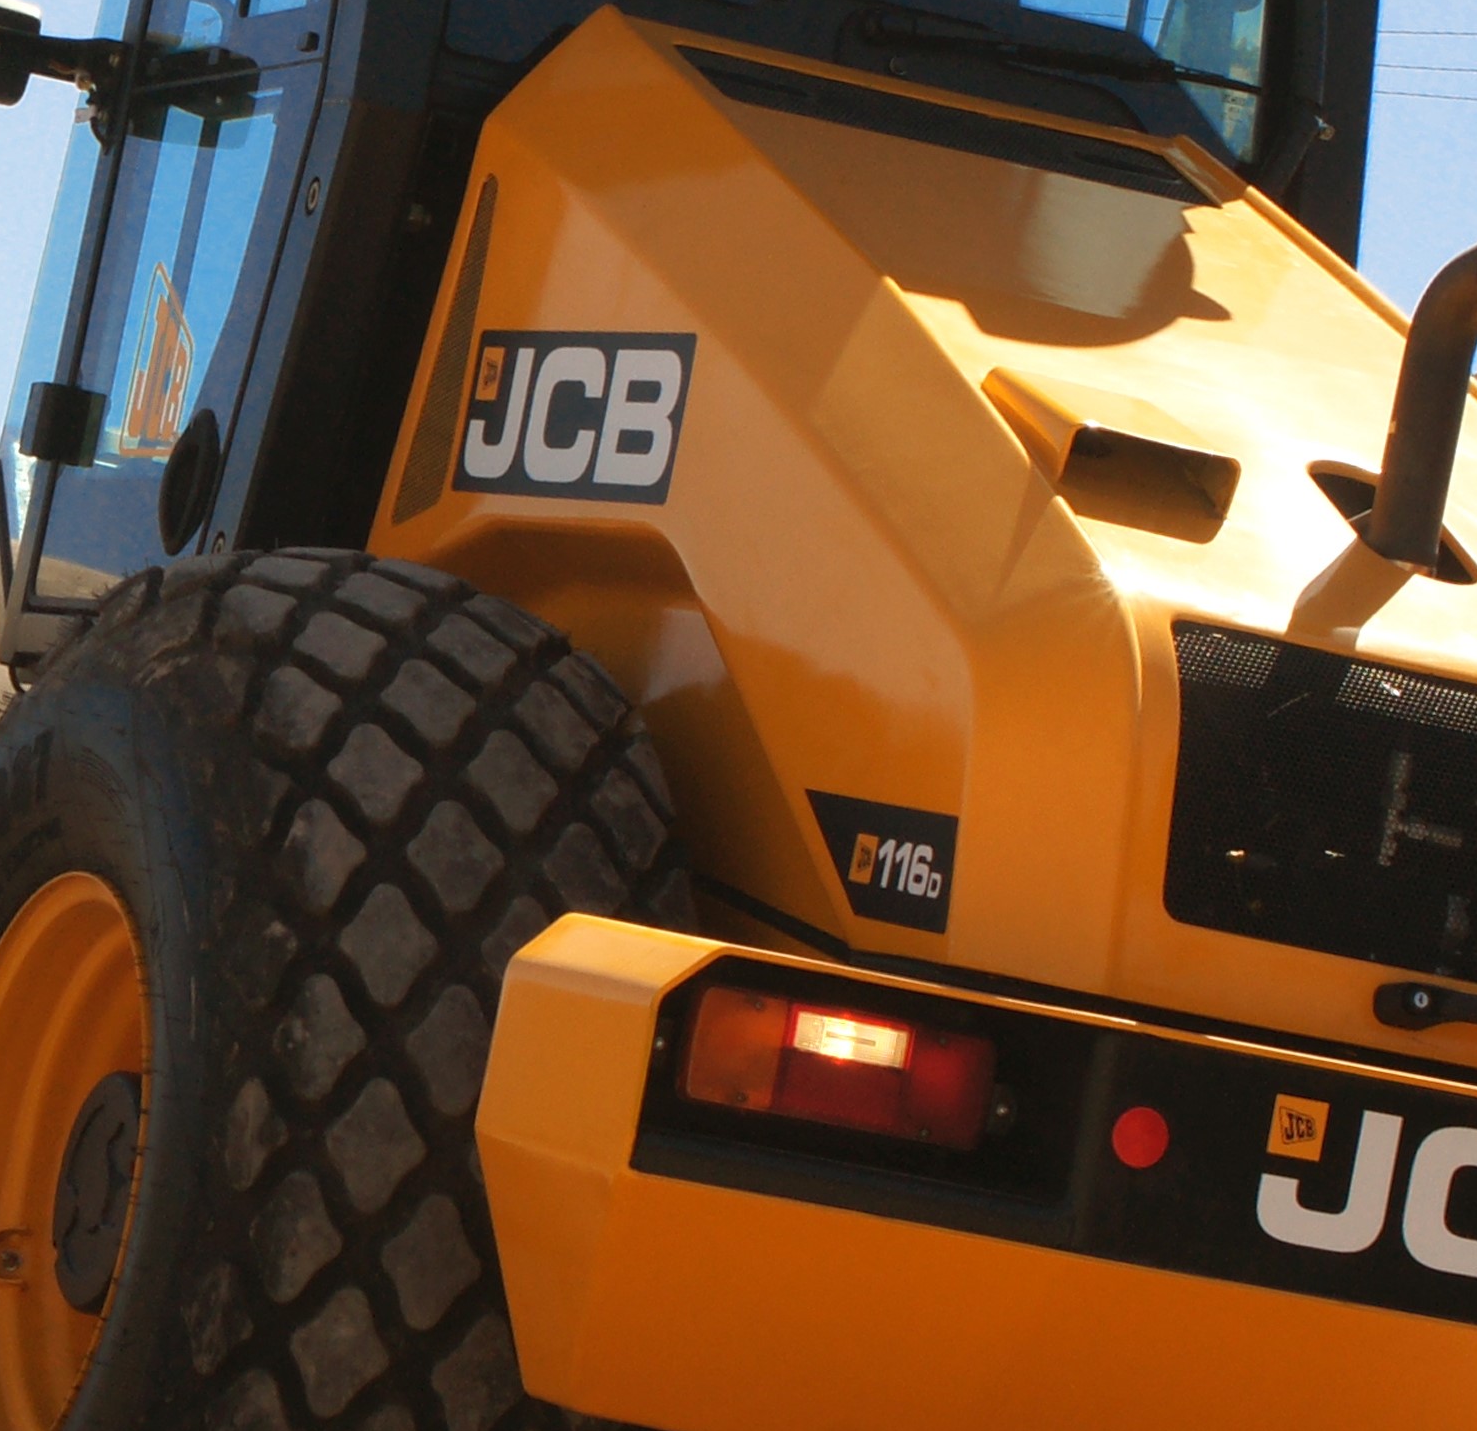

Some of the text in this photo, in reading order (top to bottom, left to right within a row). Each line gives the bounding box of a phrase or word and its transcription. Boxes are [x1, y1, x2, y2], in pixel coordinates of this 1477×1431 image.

[464, 346, 682, 487] JCB
[878, 838, 943, 899] 116D
[1283, 1111, 1317, 1141] JCB
